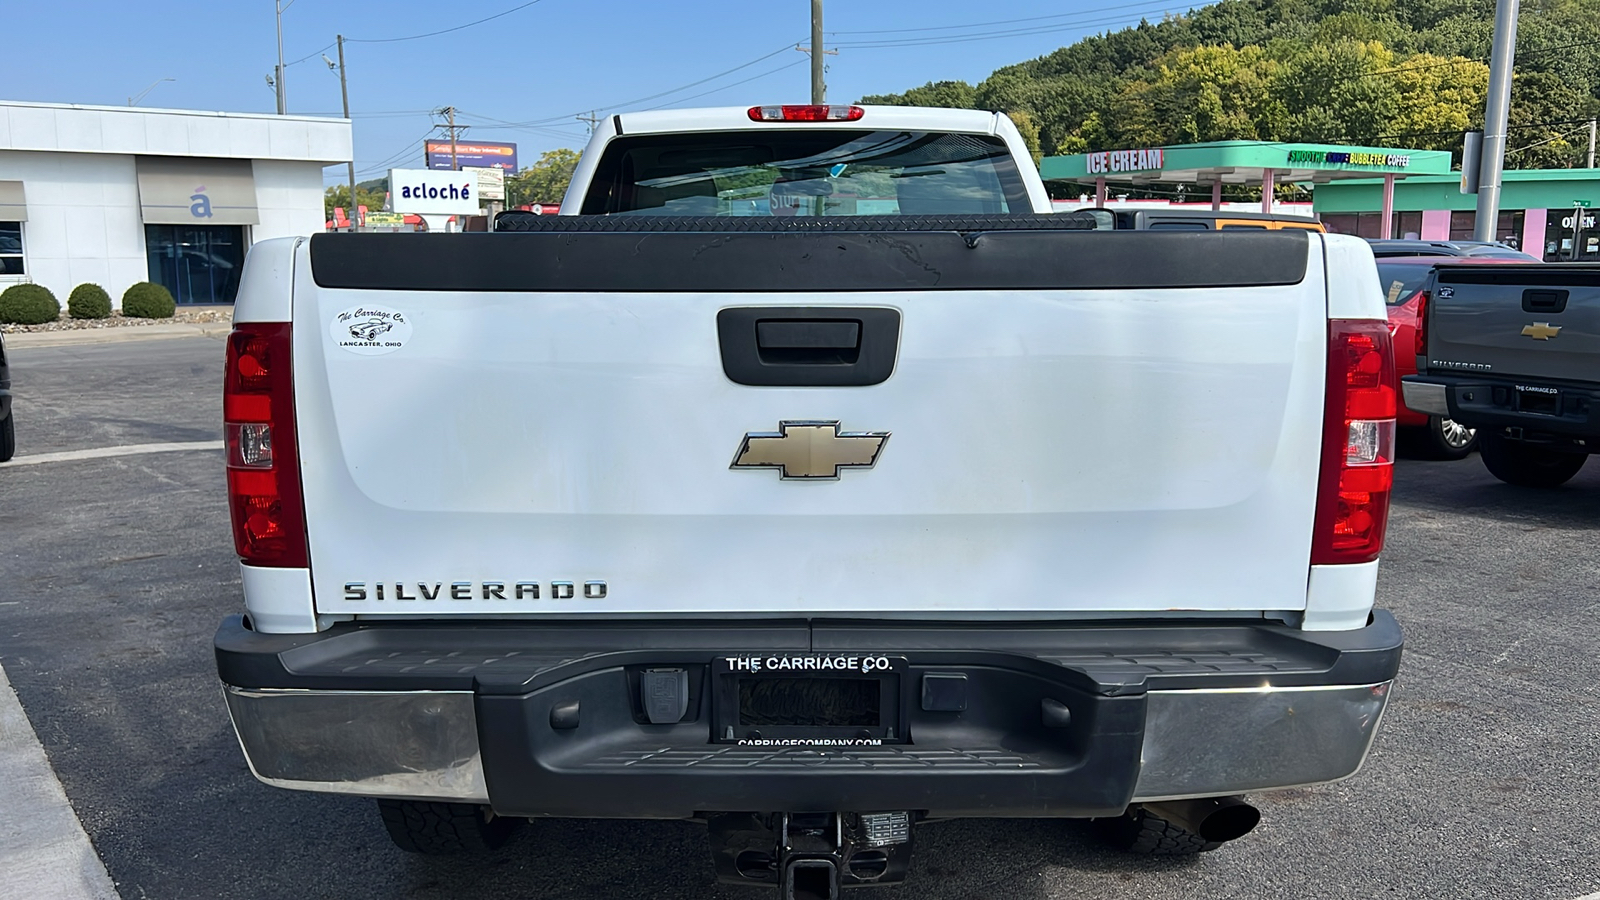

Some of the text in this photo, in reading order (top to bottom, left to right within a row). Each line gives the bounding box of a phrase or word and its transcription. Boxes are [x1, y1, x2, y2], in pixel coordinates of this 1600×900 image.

[1086, 149, 1163, 174] ICE CREAM
[1387, 154, 1410, 166] COFFEE
[401, 182, 470, 200] acloché
[337, 307, 406, 324] The Carriage Co.
[1432, 360, 1492, 370] SILVERADO
[1525, 385, 1549, 393] CARRIAGE
[344, 580, 608, 601] SILVERADO
[725, 656, 893, 670] THE CARRIAGE CO.
